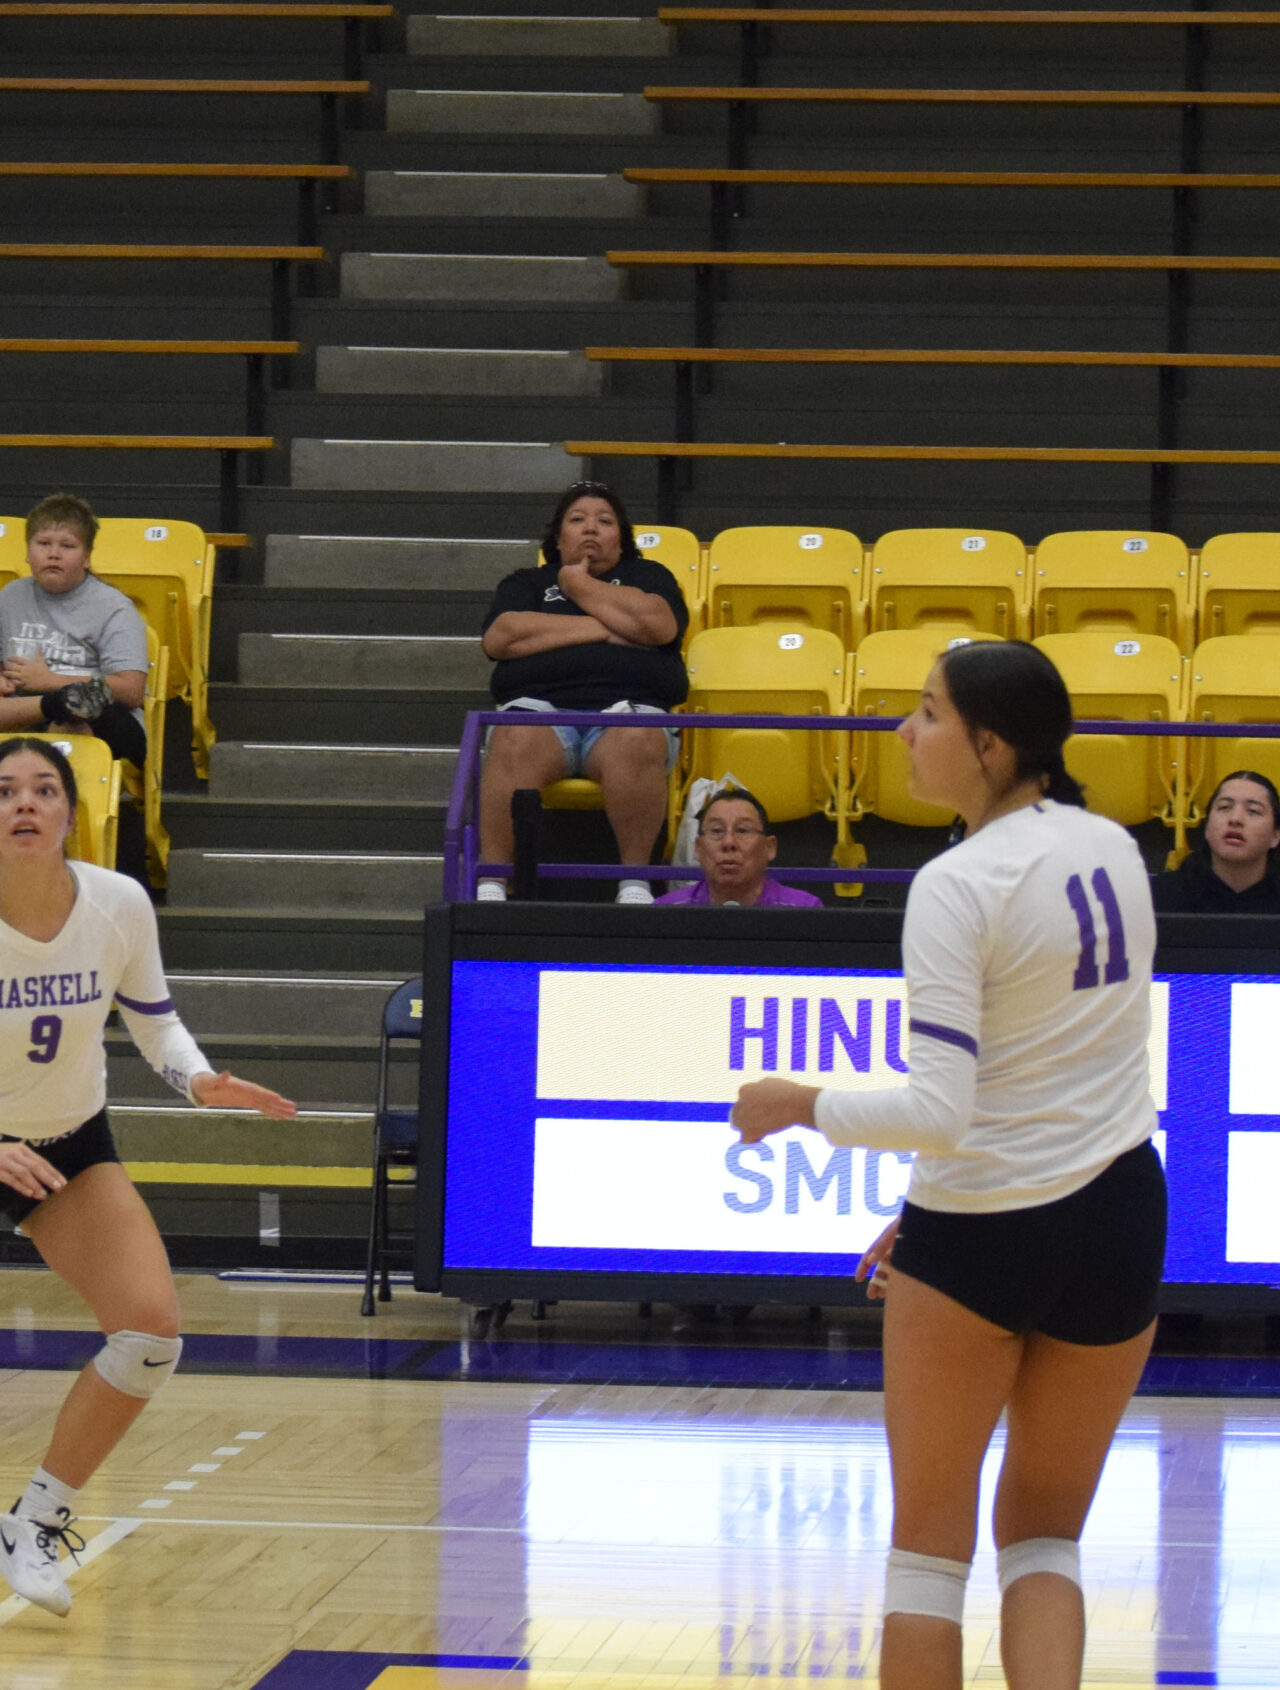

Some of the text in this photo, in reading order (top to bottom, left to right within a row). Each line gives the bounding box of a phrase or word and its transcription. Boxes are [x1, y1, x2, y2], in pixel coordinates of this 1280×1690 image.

[1065, 866, 1130, 992] 11
[26, 1013, 64, 1065] 9
[722, 1139, 914, 1217] SMC
